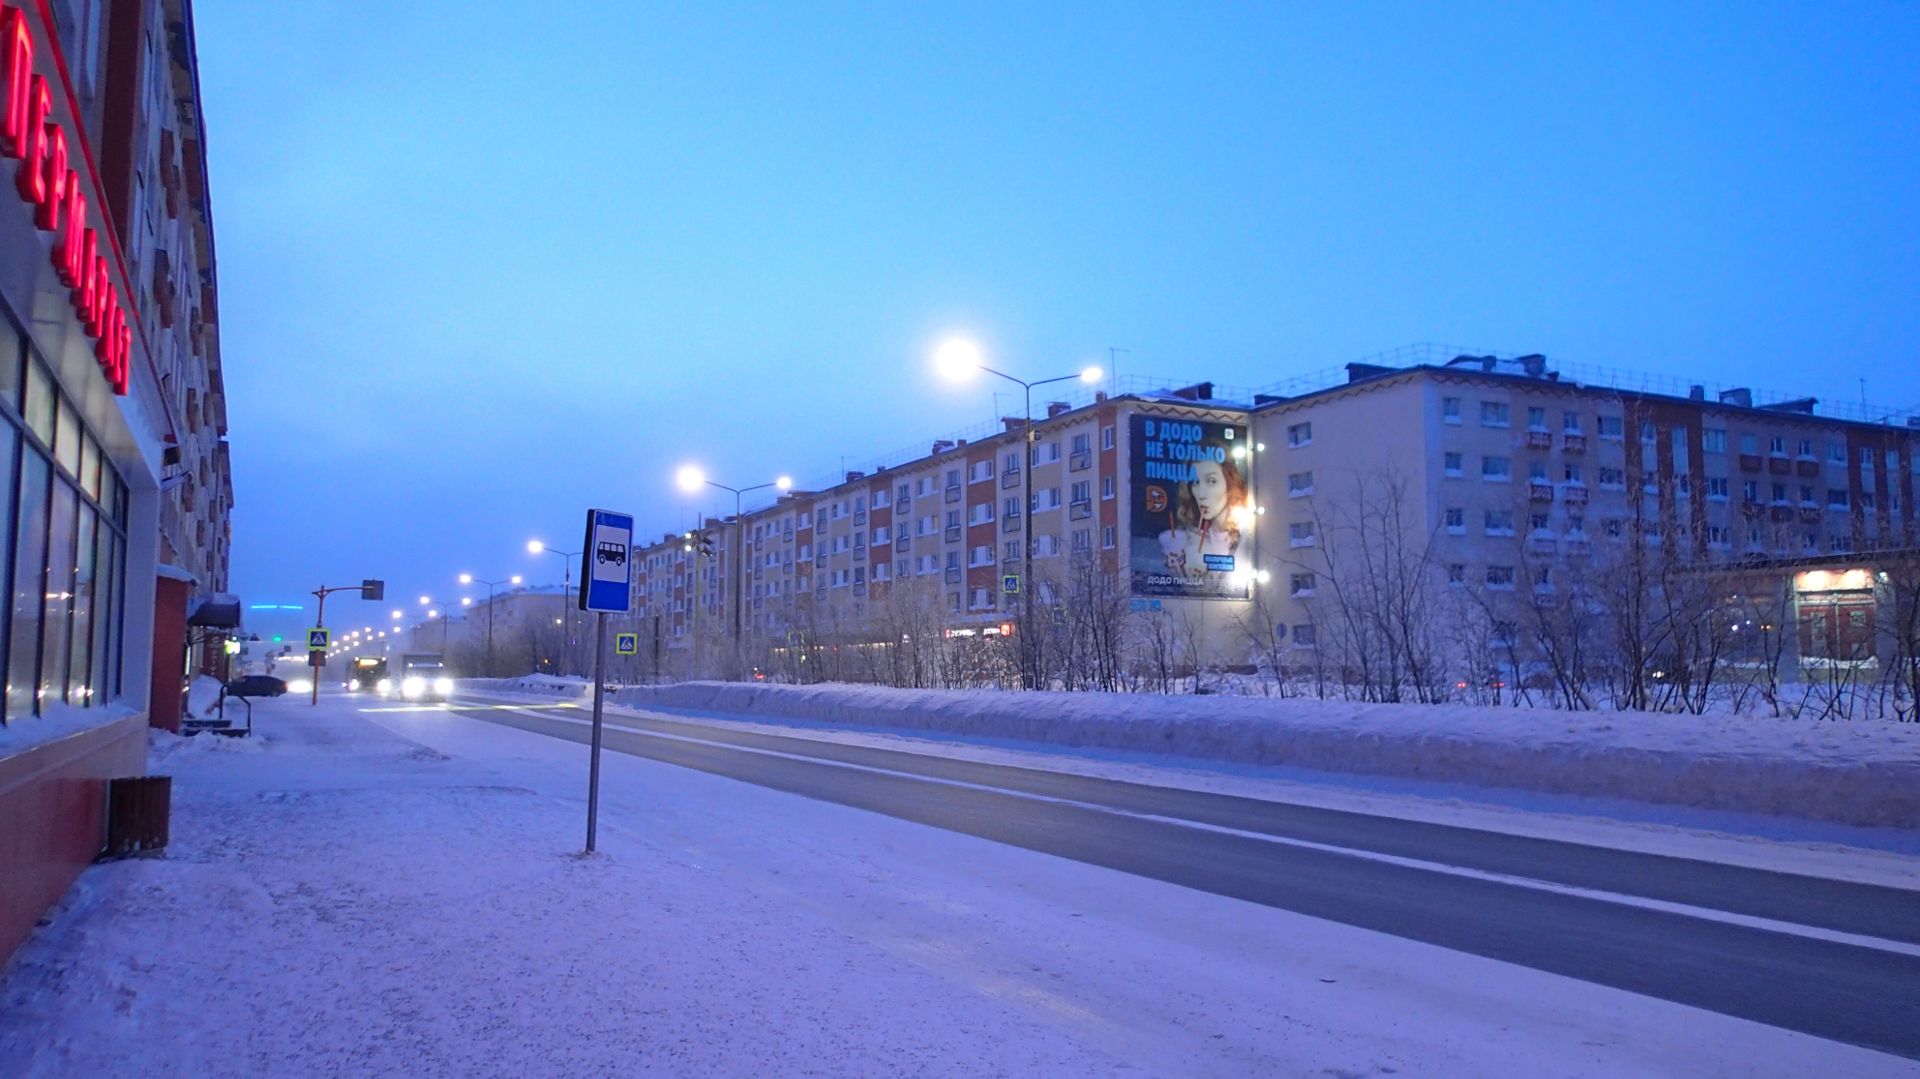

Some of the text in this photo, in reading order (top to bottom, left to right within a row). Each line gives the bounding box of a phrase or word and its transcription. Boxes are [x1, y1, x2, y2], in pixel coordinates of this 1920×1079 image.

[0, 0, 132, 396] ПЕРМАРКЕТ
[1145, 420, 1202, 444] В ДОДО
[1145, 440, 1226, 464] НЕ ТОЛЬКО
[1145, 461, 1199, 484] ПИЦЦА
[1147, 576, 1204, 587] ДОДО ПИЦЦА
